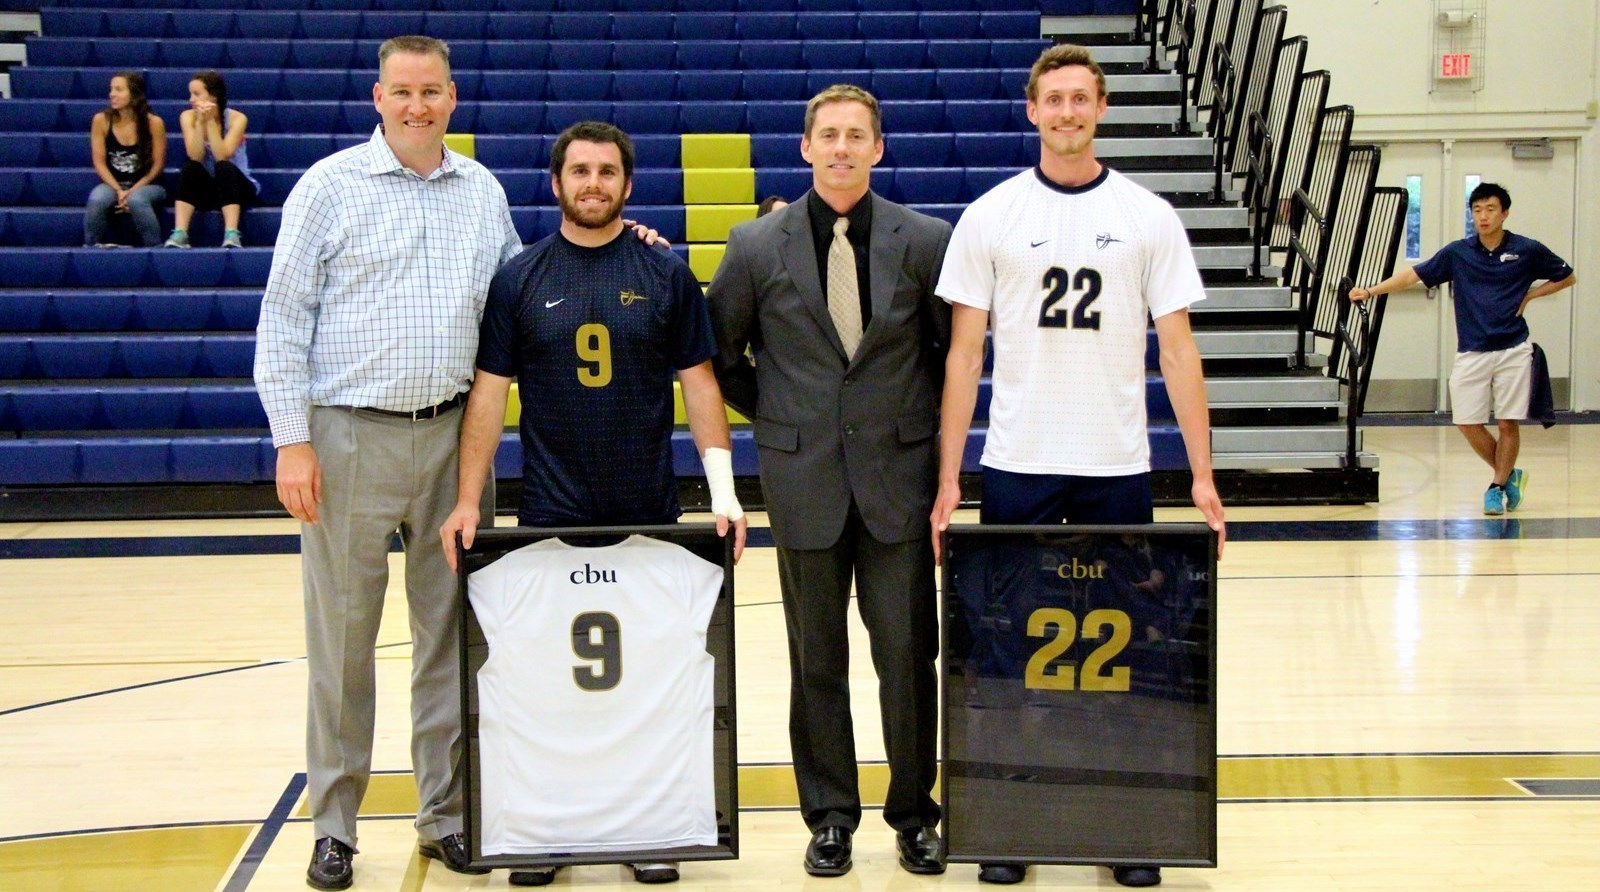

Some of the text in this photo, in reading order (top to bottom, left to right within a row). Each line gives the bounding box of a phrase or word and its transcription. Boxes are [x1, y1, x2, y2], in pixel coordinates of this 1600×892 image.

[1442, 54, 1470, 76] EXIT
[1038, 266, 1102, 331] 22
[575, 323, 612, 388] 9
[569, 563, 617, 584] cbu
[1057, 557, 1104, 579] cbu
[570, 610, 623, 692] 9
[1024, 607, 1132, 691] 22
